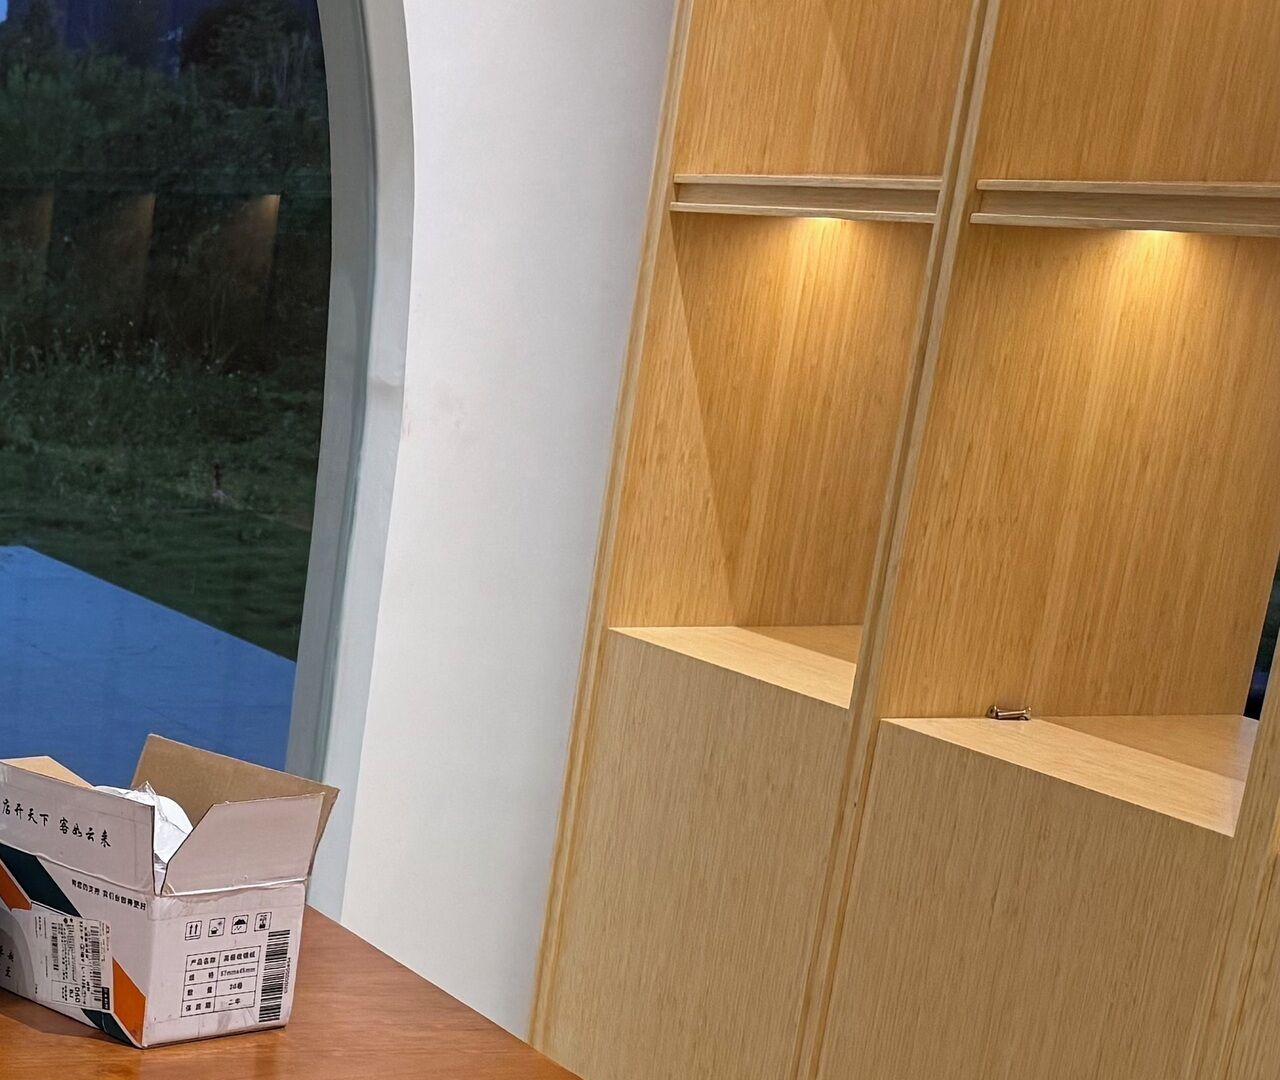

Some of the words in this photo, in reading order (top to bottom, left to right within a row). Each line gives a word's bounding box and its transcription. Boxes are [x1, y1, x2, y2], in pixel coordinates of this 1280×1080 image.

[2, 798, 49, 827] 店开天下
[59, 817, 111, 848] 客如云来
